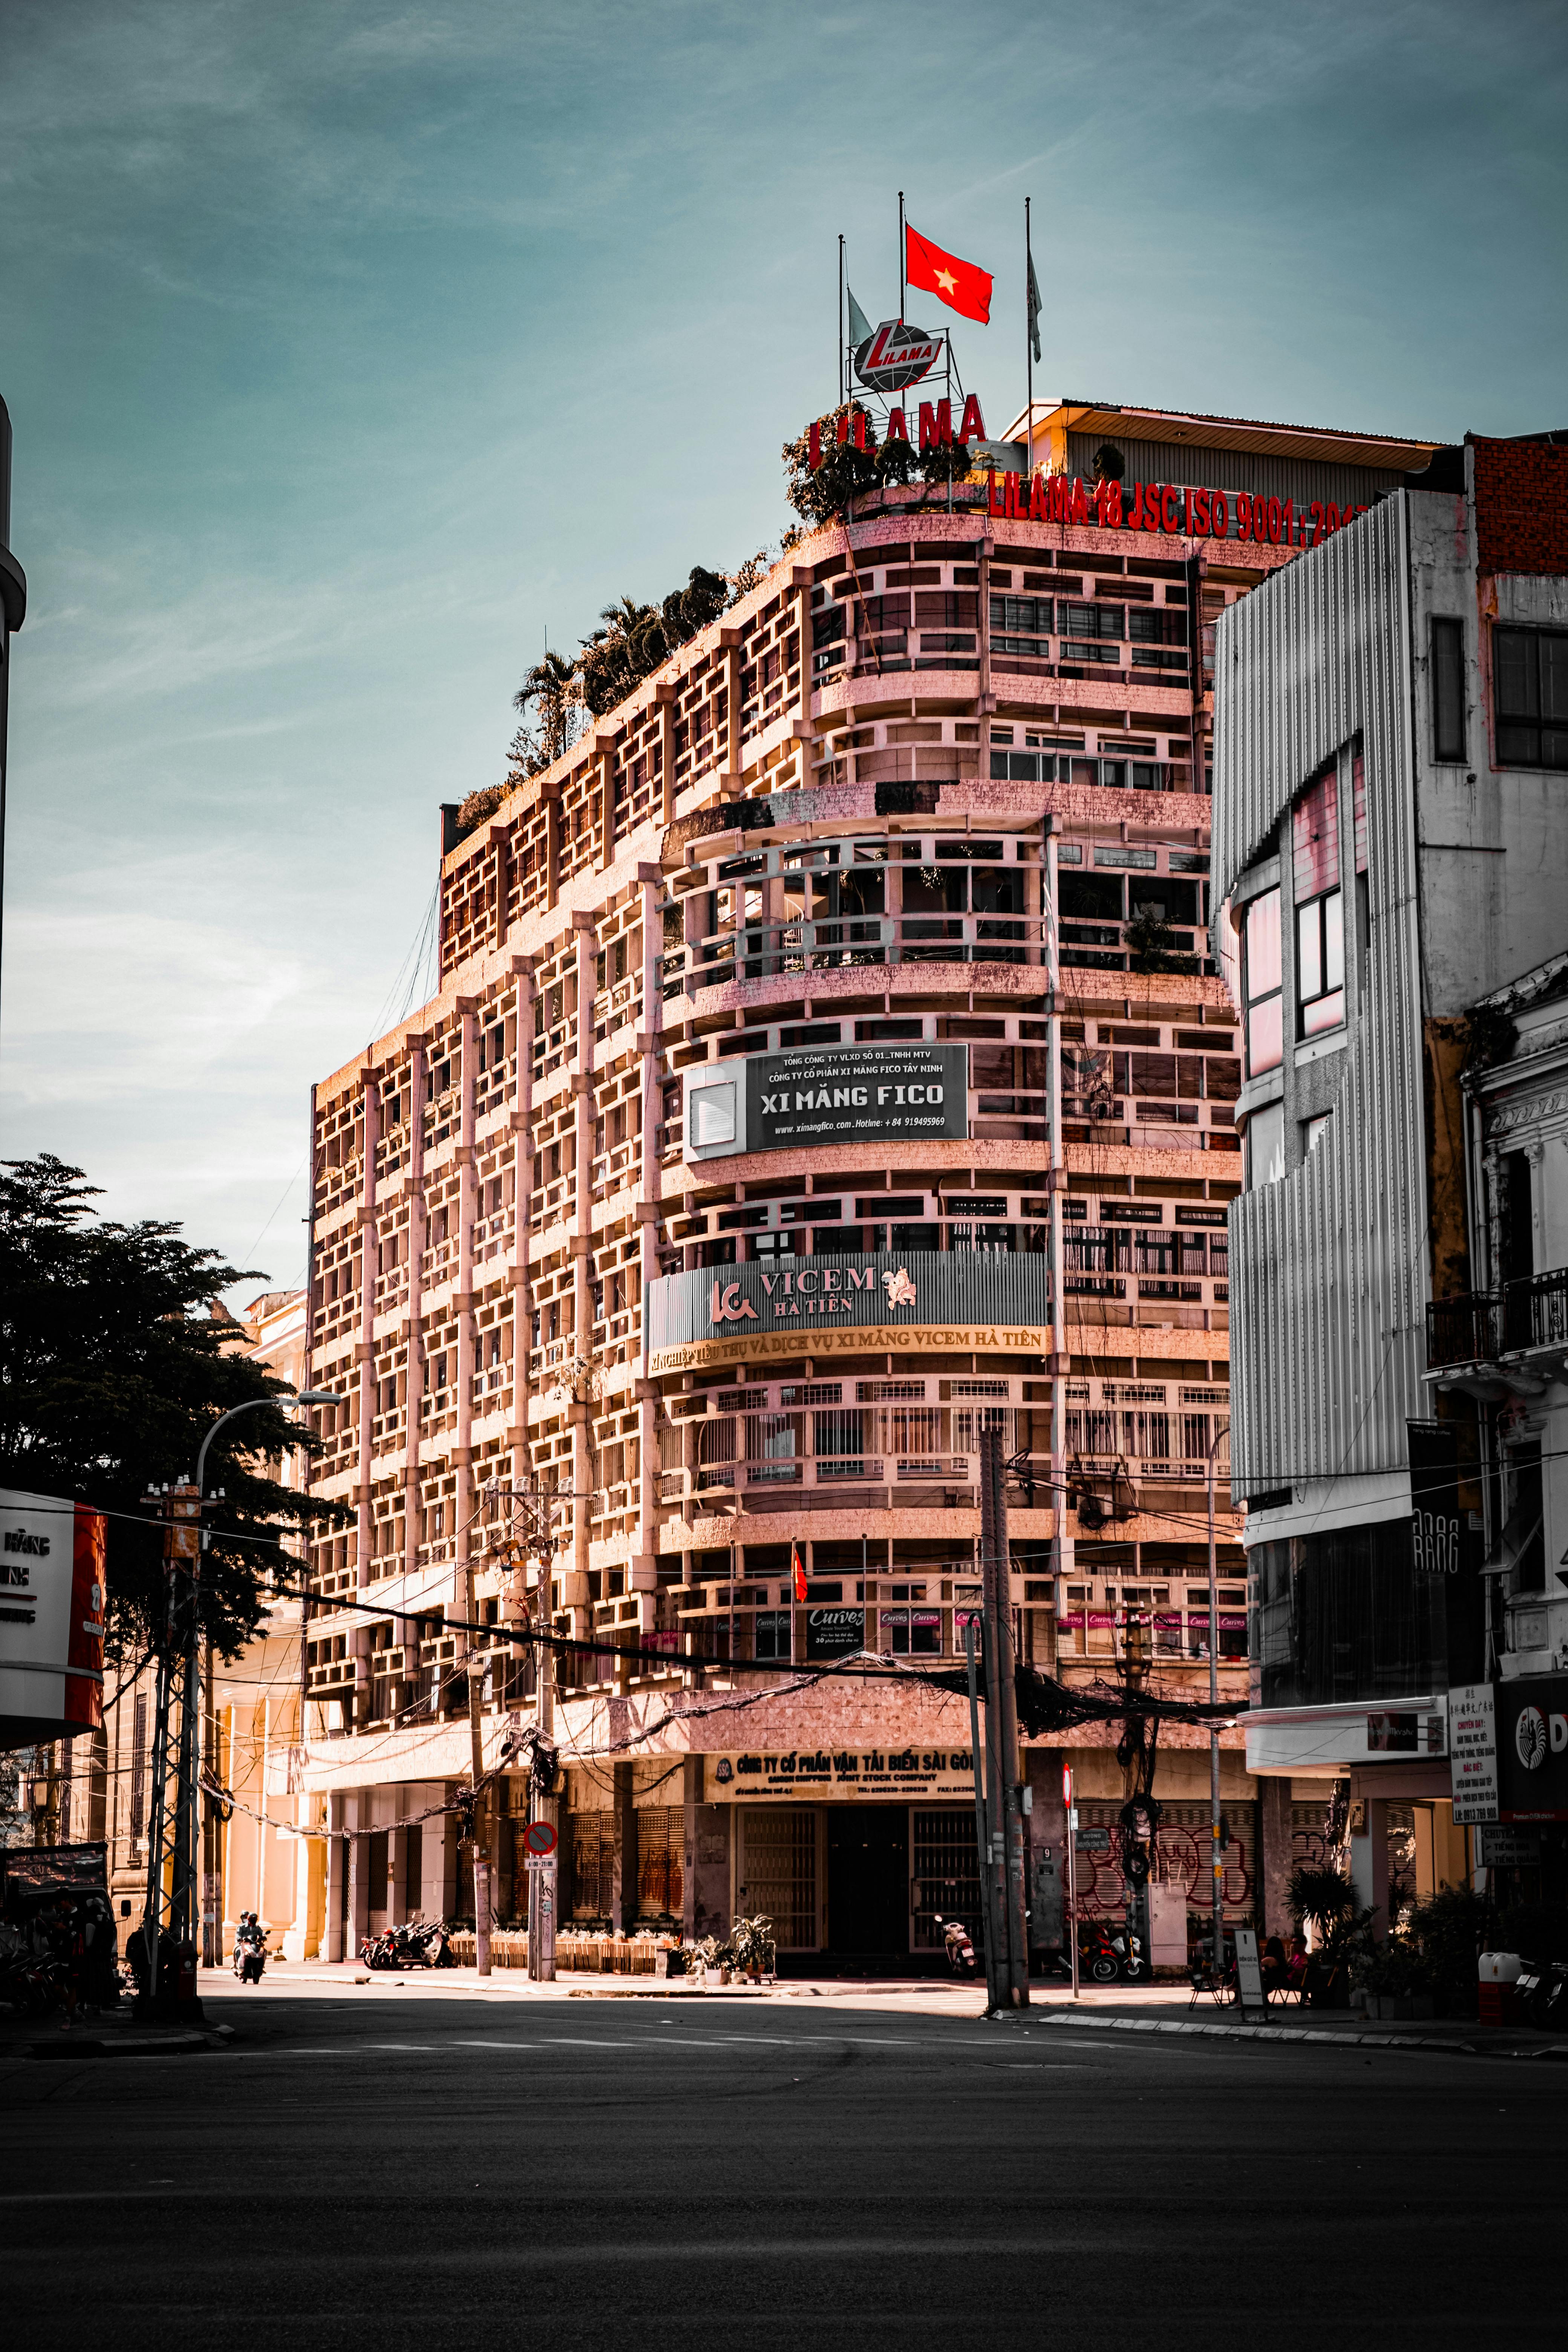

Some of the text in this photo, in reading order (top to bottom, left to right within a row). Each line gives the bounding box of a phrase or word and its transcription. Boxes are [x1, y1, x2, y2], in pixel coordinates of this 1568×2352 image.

[866, 326, 933, 369] LILAMA
[989, 469, 1089, 525] LILAMA
[1095, 479, 1122, 528] 18
[1128, 482, 1178, 533] JSC
[1186, 488, 1229, 538] ISO
[784, 1053, 802, 1066] TỔNG
[805, 1055, 824, 1064] CÔNG
[862, 1048, 873, 1060] SỐ
[769, 1072, 790, 1083] CÔNG
[804, 1066, 815, 1078] CỔ
[816, 1065, 838, 1077] PHẦN
[853, 1064, 878, 1075] MĂNG
[903, 1063, 918, 1073] TÂY
[761, 1083, 943, 1114] XI MĂNG FICO
[905, 1117, 945, 1126] 919495969
[760, 1267, 876, 1296] VICEM
[774, 1293, 853, 1317] HÀ TIÊN
[660, 1348, 693, 1368] NGHIỆP
[693, 1341, 720, 1361] TIÊU
[723, 1340, 747, 1358] THỤ
[751, 1335, 769, 1354] VÀ
[772, 1335, 809, 1354] DỊCH
[812, 1334, 834, 1352] VỤ
[837, 1333, 856, 1348] XI
[859, 1329, 910, 1346] MĂNG
[914, 1332, 971, 1345] VICEM
[975, 1329, 999, 1346] HÀ
[1003, 1329, 1042, 1346] TIÊN
[1413, 1532, 1459, 1574] RANG
[809, 1609, 864, 1626] Curves
[882, 1614, 907, 1622] Curves
[913, 1613, 939, 1622] Curves
[1222, 1618, 1245, 1626] Curves
[718, 1763, 729, 1777] SSC
[764, 1757, 778, 1773] TY
[833, 1752, 858, 1775] VẬN
[862, 1750, 884, 1771] TẢI
[888, 1749, 919, 1770] BIỂN
[923, 1750, 946, 1770] SÀI
[1464, 1809, 1476, 1821] 0913
[1477, 1808, 1486, 1819] 769
[1487, 1807, 1496, 1819] 908
[1045, 1848, 1050, 1857] 9
[1495, 1841, 1514, 1851] TIẾNG
[1495, 1853, 1514, 1864] TIẾNG
